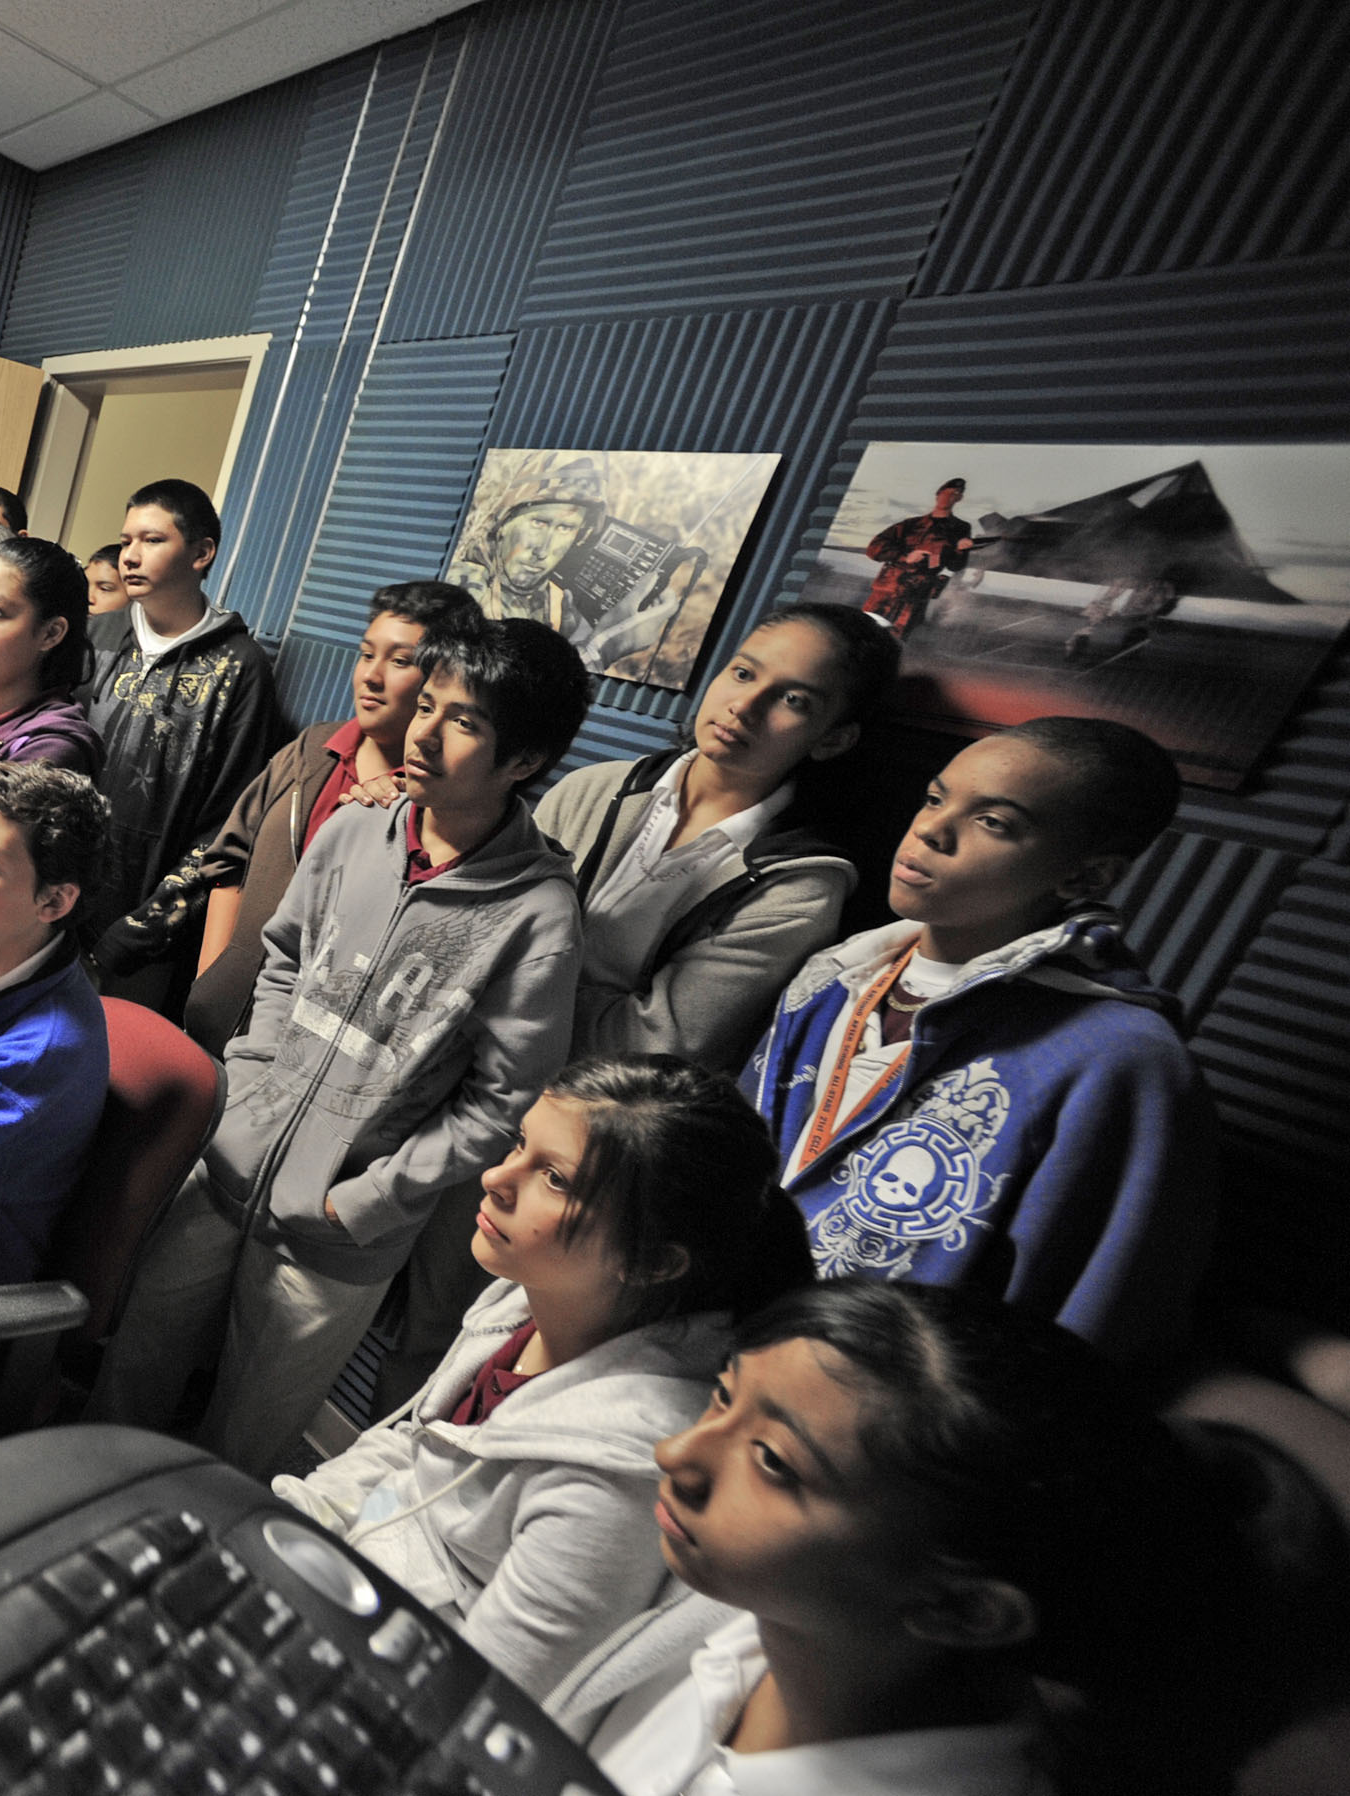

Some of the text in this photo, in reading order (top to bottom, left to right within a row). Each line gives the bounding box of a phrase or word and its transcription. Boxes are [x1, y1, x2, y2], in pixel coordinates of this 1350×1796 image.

[856, 990, 878, 1017] ANTONIO
[847, 1019, 859, 1042] AFTER
[837, 1045, 850, 1070] SCHOOL
[824, 1075, 840, 1113] ALL-STARS
